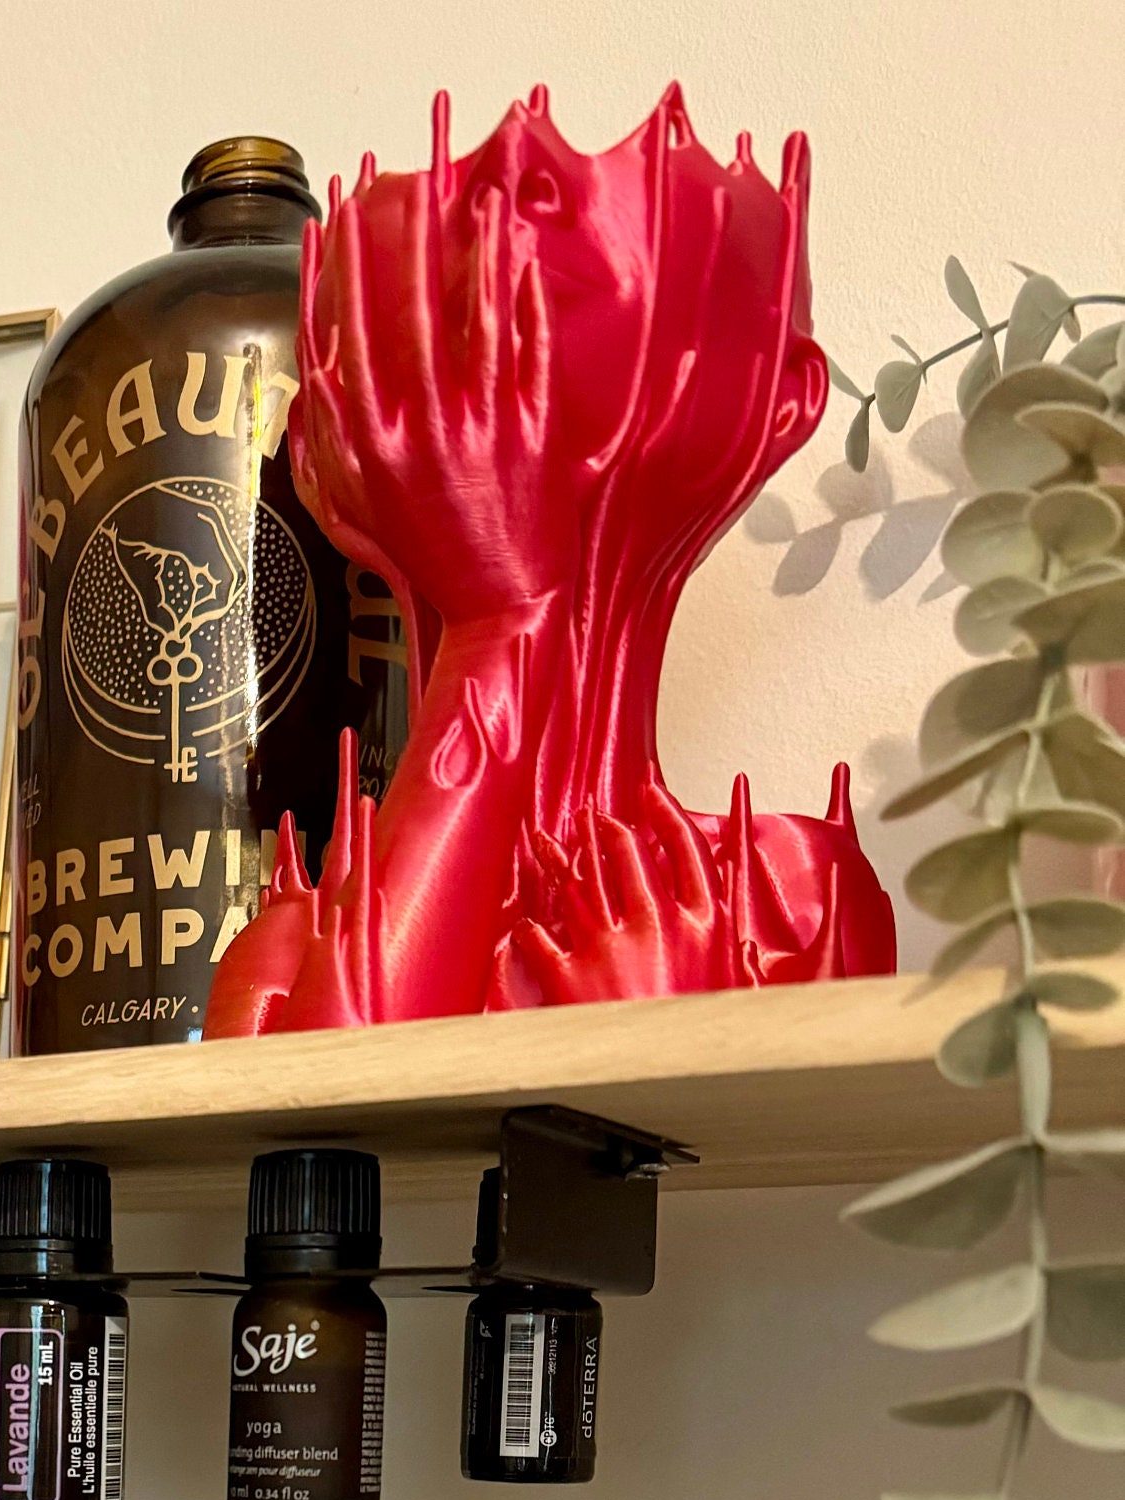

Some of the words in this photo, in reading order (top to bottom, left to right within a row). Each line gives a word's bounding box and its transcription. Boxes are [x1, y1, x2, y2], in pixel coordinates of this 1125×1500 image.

[21, 904, 250, 988] COMPA
[80, 996, 187, 1027] CALGARY
[38, 1341, 54, 1364] mL
[88, 1346, 101, 1377] pure
[37, 1366, 53, 1387] 15
[69, 1361, 84, 1381] Oil
[262, 1383, 317, 1393] WELLNESS
[2, 1362, 31, 1493] Lavande
[68, 1384, 84, 1444] Essential
[84, 1383, 97, 1449] essentielle
[245, 1420, 282, 1438] yoga
[67, 1446, 81, 1478] Pure
[255, 1445, 300, 1460] diffuser
[302, 1446, 339, 1461] blend
[82, 1452, 96, 1495] L'huile
[278, 1464, 322, 1480] diffuseur
[254, 1486, 279, 1500] 0.34
[281, 1485, 291, 1500] fl
[293, 1489, 310, 1500] oz
